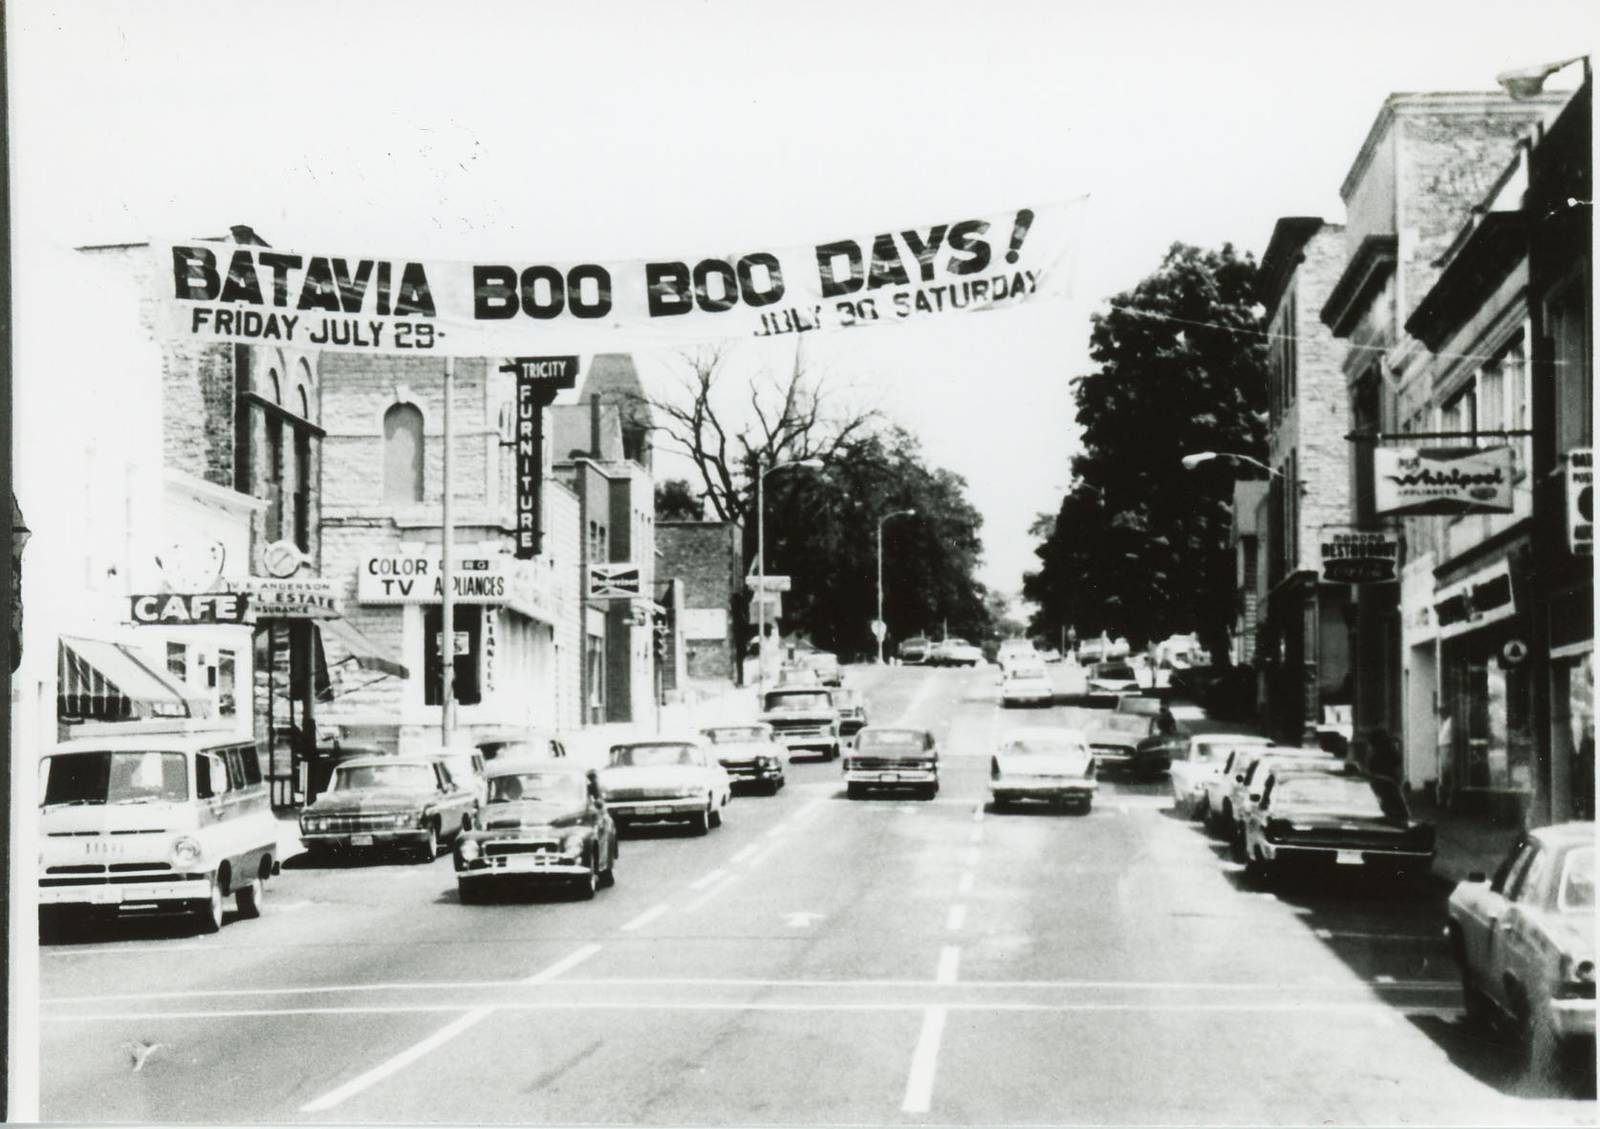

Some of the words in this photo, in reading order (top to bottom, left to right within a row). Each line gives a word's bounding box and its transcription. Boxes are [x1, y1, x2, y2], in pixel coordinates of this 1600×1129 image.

[172, 246, 437, 317] BATAVIA
[473, 264, 612, 319] BOO
[646, 252, 785, 317] BOO
[754, 305, 822, 336] JULY
[892, 268, 1042, 318] SATURDAY
[192, 307, 299, 341] FRIDAY
[310, 319, 384, 347] JULY
[522, 361, 567, 378] TRICITY
[520, 385, 534, 549] FURNITURE
[368, 558, 428, 575] COLOR
[382, 579, 414, 596] TV
[434, 576, 504, 596] APLIANCES
[133, 595, 239, 622] CAFE
[275, 592, 335, 609] ESTATE
